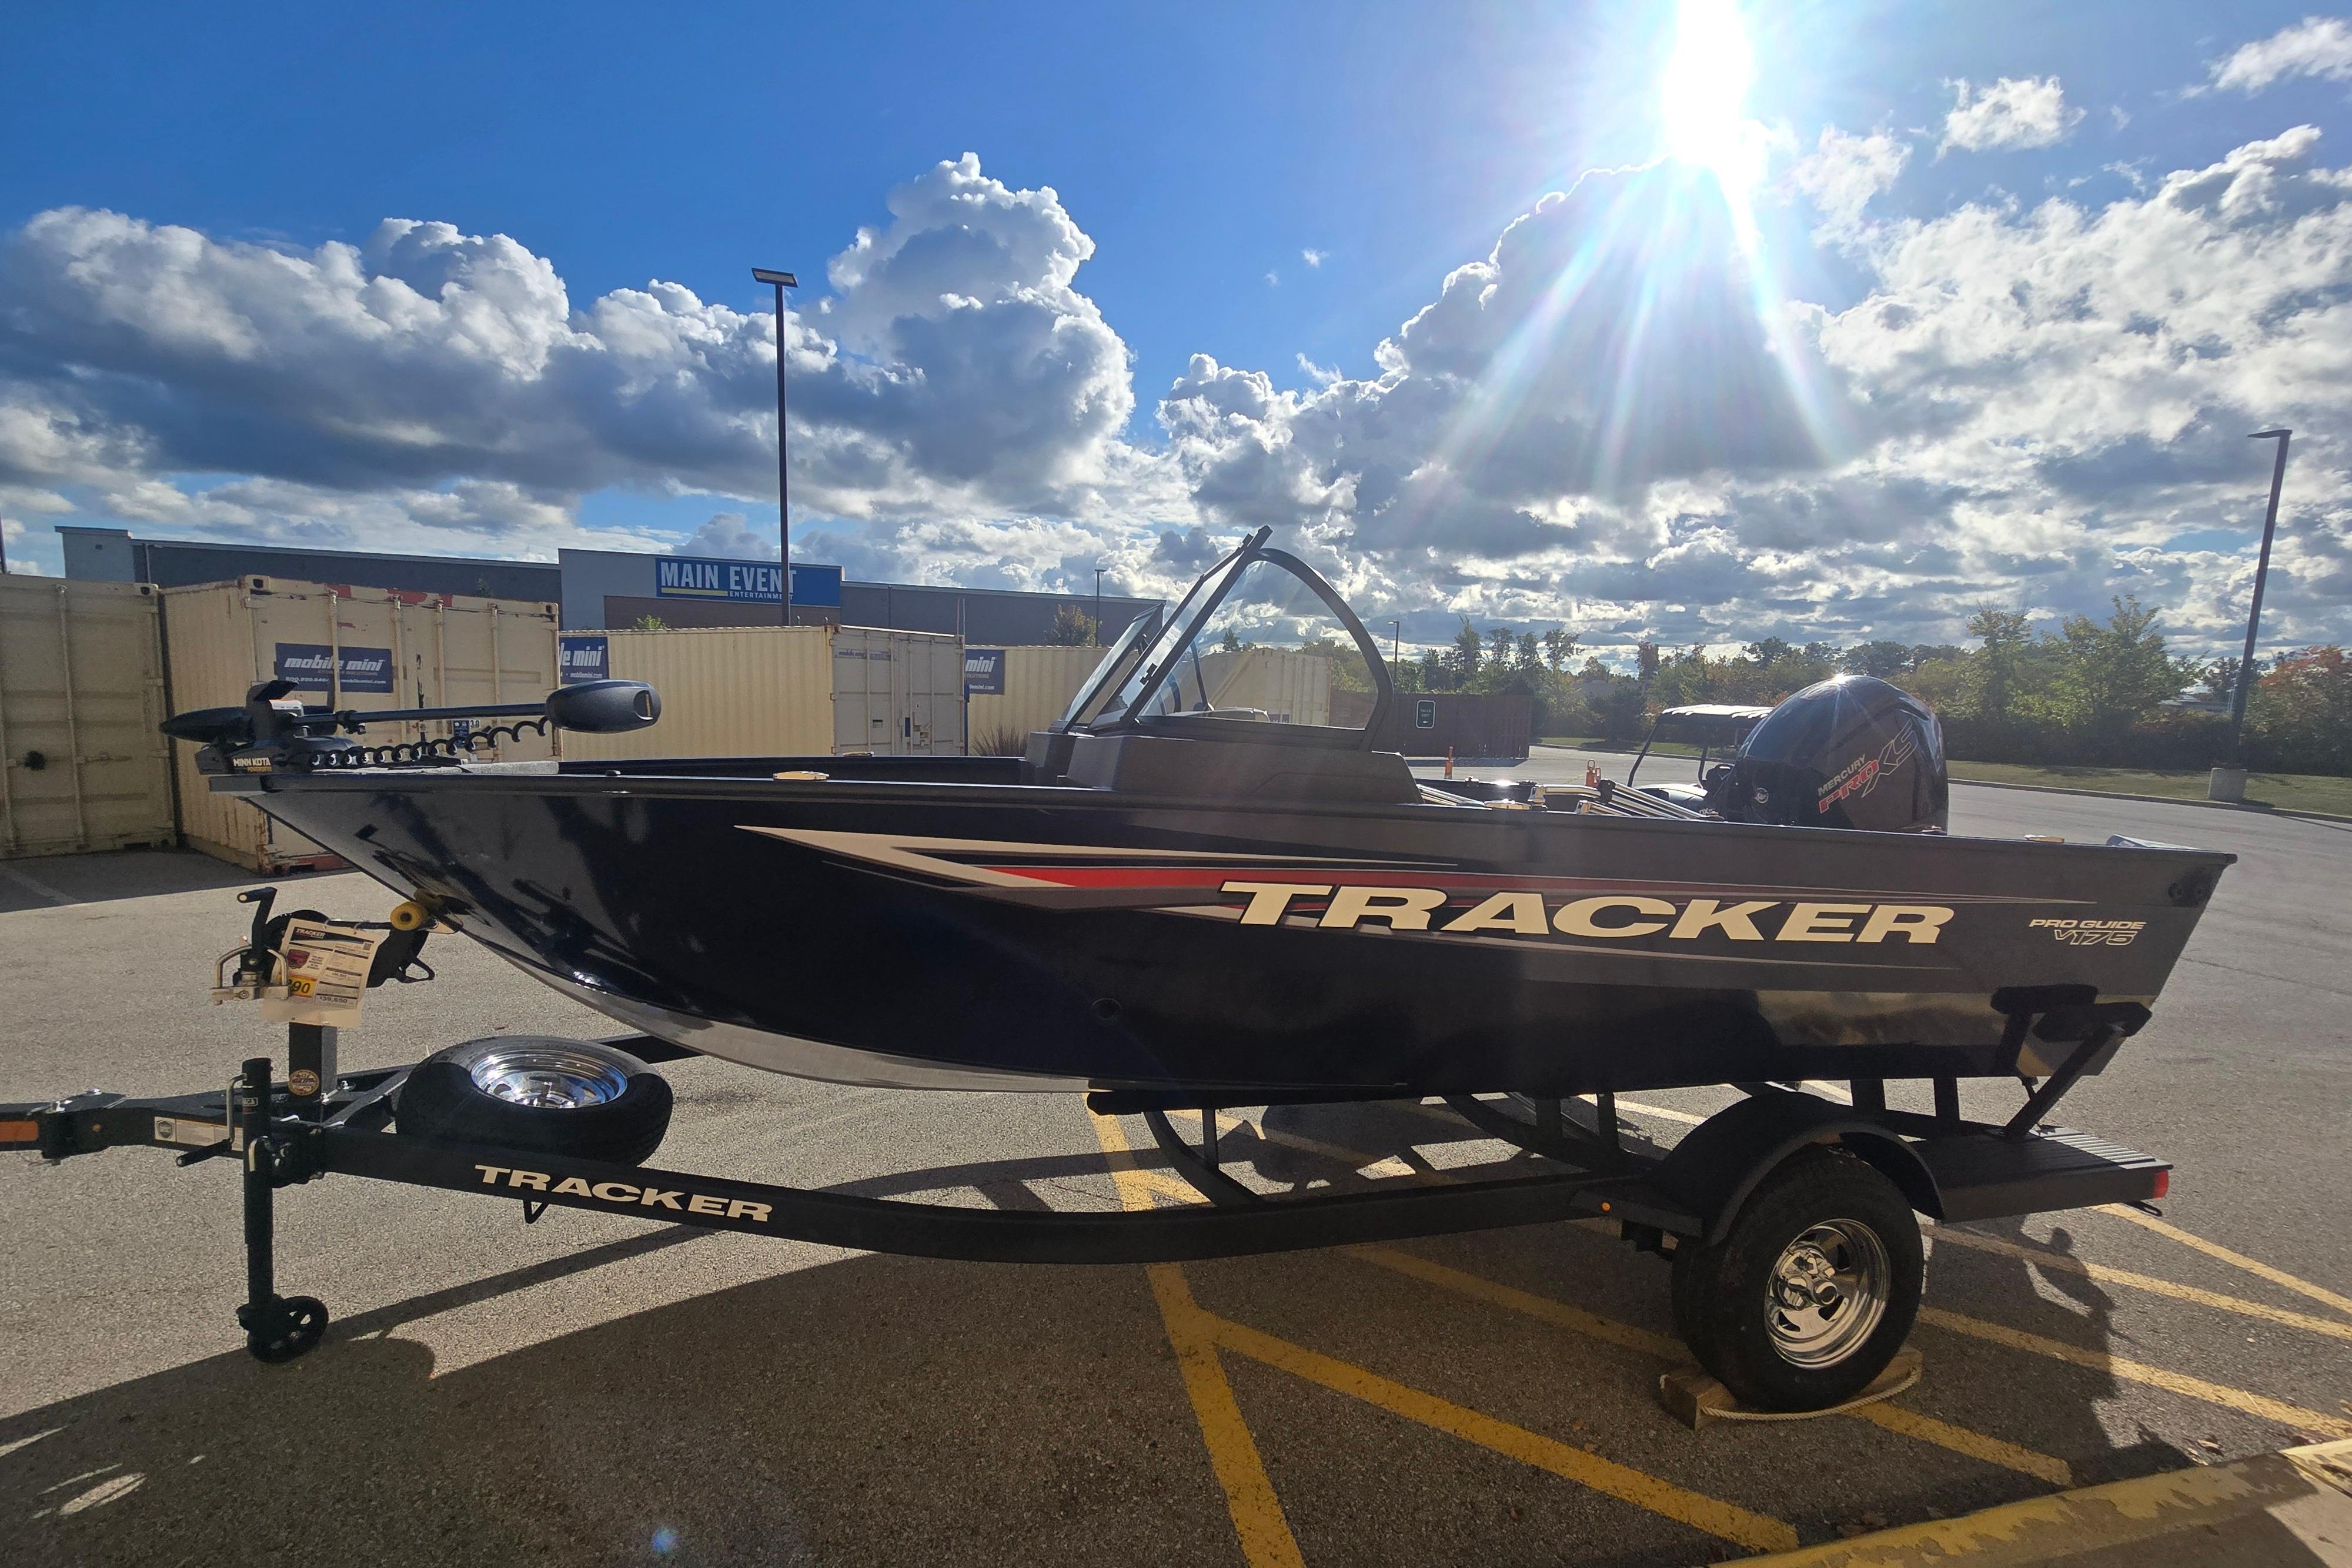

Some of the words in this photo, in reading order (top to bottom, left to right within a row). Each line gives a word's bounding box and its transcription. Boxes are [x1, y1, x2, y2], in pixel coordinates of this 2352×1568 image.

[660, 561, 719, 589] MAIN
[730, 591, 793, 600] ENTERTAINMET
[346, 658, 383, 671] mini
[572, 646, 603, 666] mini
[965, 656, 996, 673] mini
[233, 758, 252, 767] MINN
[252, 757, 271, 765] KOTA
[1818, 754, 1866, 797] MERCURY
[1819, 759, 1879, 814] PRO
[1221, 881, 1955, 944] TRACKER
[296, 928, 326, 939] TRACKER
[2029, 919, 2079, 928] PRO
[2079, 920, 2147, 930] GUIDE
[475, 1164, 773, 1222] TRACKER
